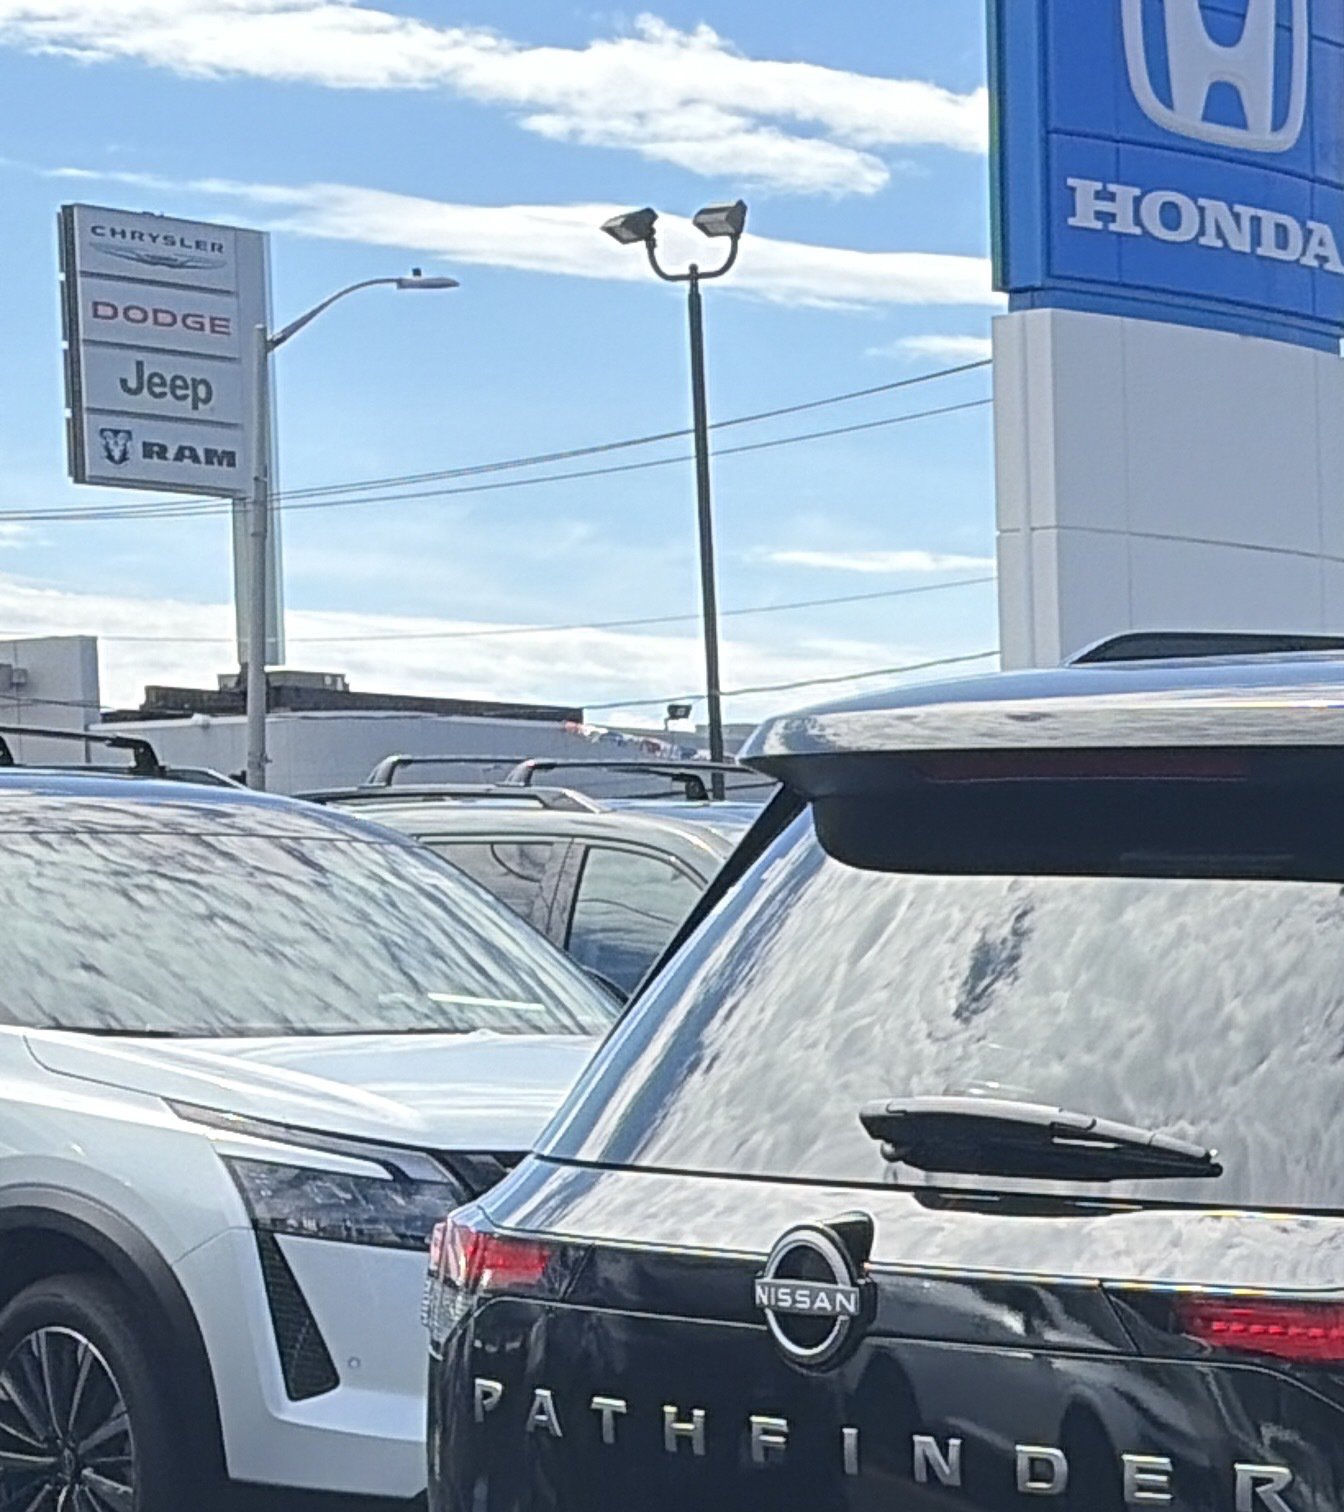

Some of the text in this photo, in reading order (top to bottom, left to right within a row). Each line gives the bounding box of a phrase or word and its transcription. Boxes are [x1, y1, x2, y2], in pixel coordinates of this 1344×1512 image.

[90, 224, 225, 255] CHRYSLER
[91, 300, 232, 336] DODGE
[119, 360, 214, 411] Jeep
[141, 440, 237, 468] RAM
[755, 1284, 857, 1314] NISSAN
